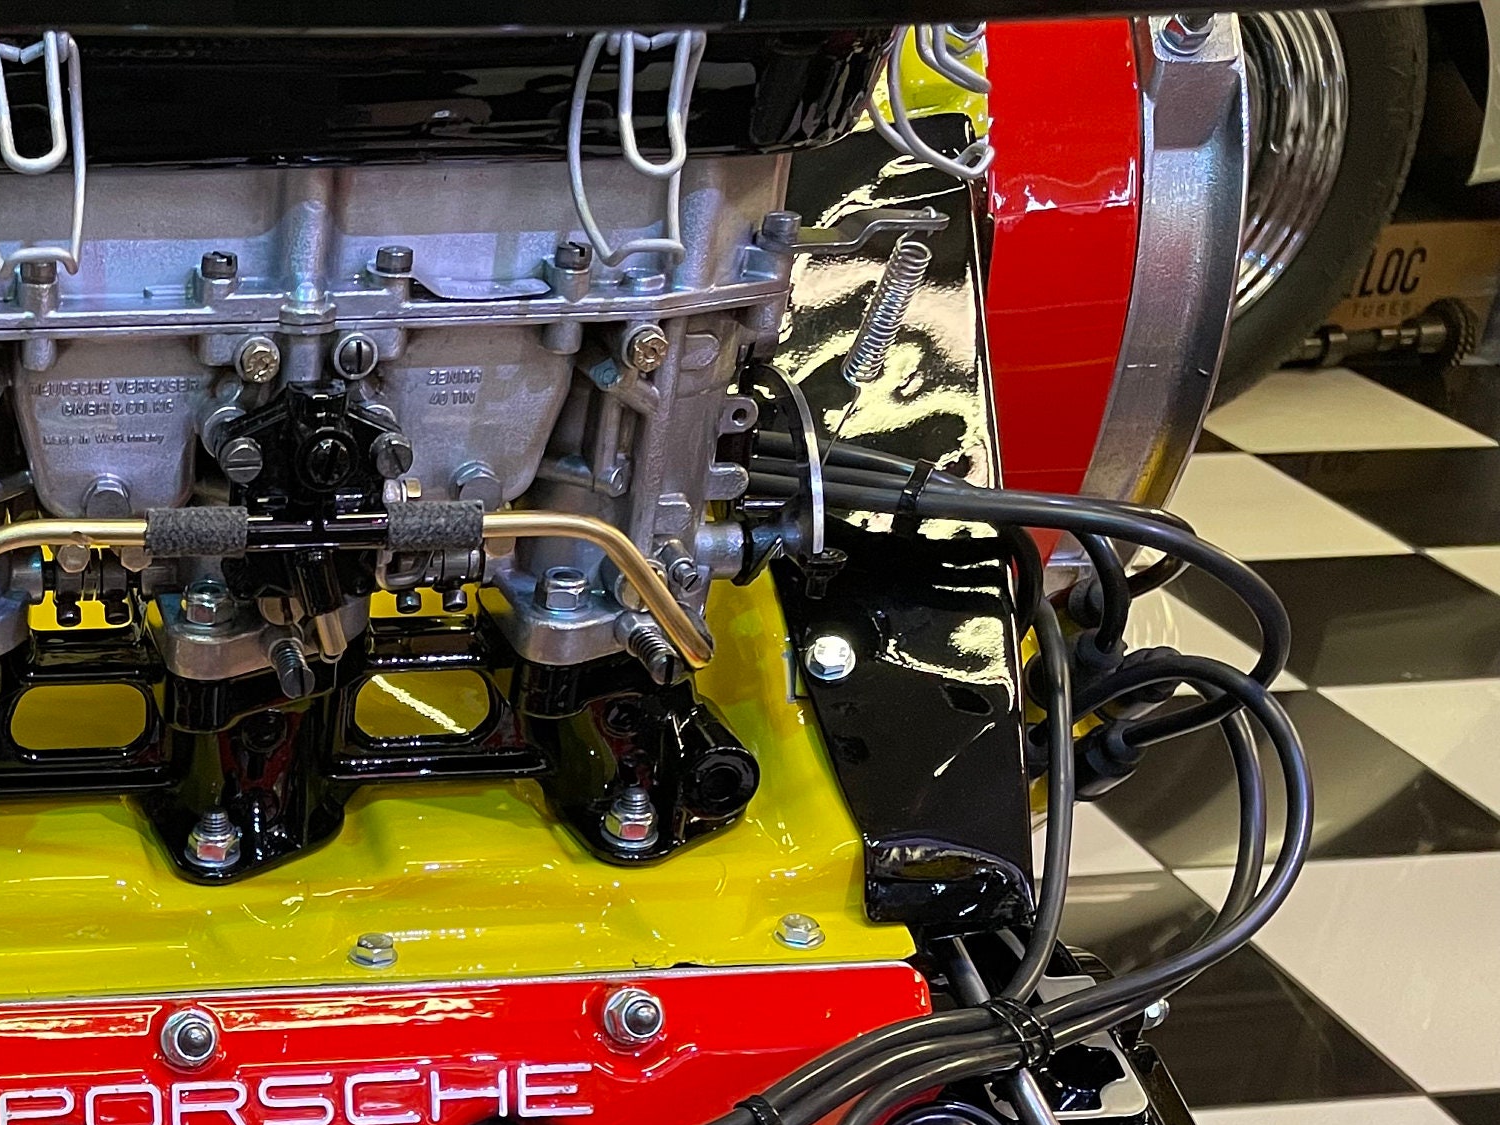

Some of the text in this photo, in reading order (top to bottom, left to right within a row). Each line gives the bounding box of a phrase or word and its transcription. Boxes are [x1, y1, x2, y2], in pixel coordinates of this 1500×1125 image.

[1343, 246, 1428, 298] LOC
[426, 368, 483, 386] ZENITH
[30, 378, 200, 397] DEUTSCHE VERGASER
[429, 389, 477, 406] 40 TIN
[61, 401, 109, 417] GMBH
[78, 433, 90, 445] in
